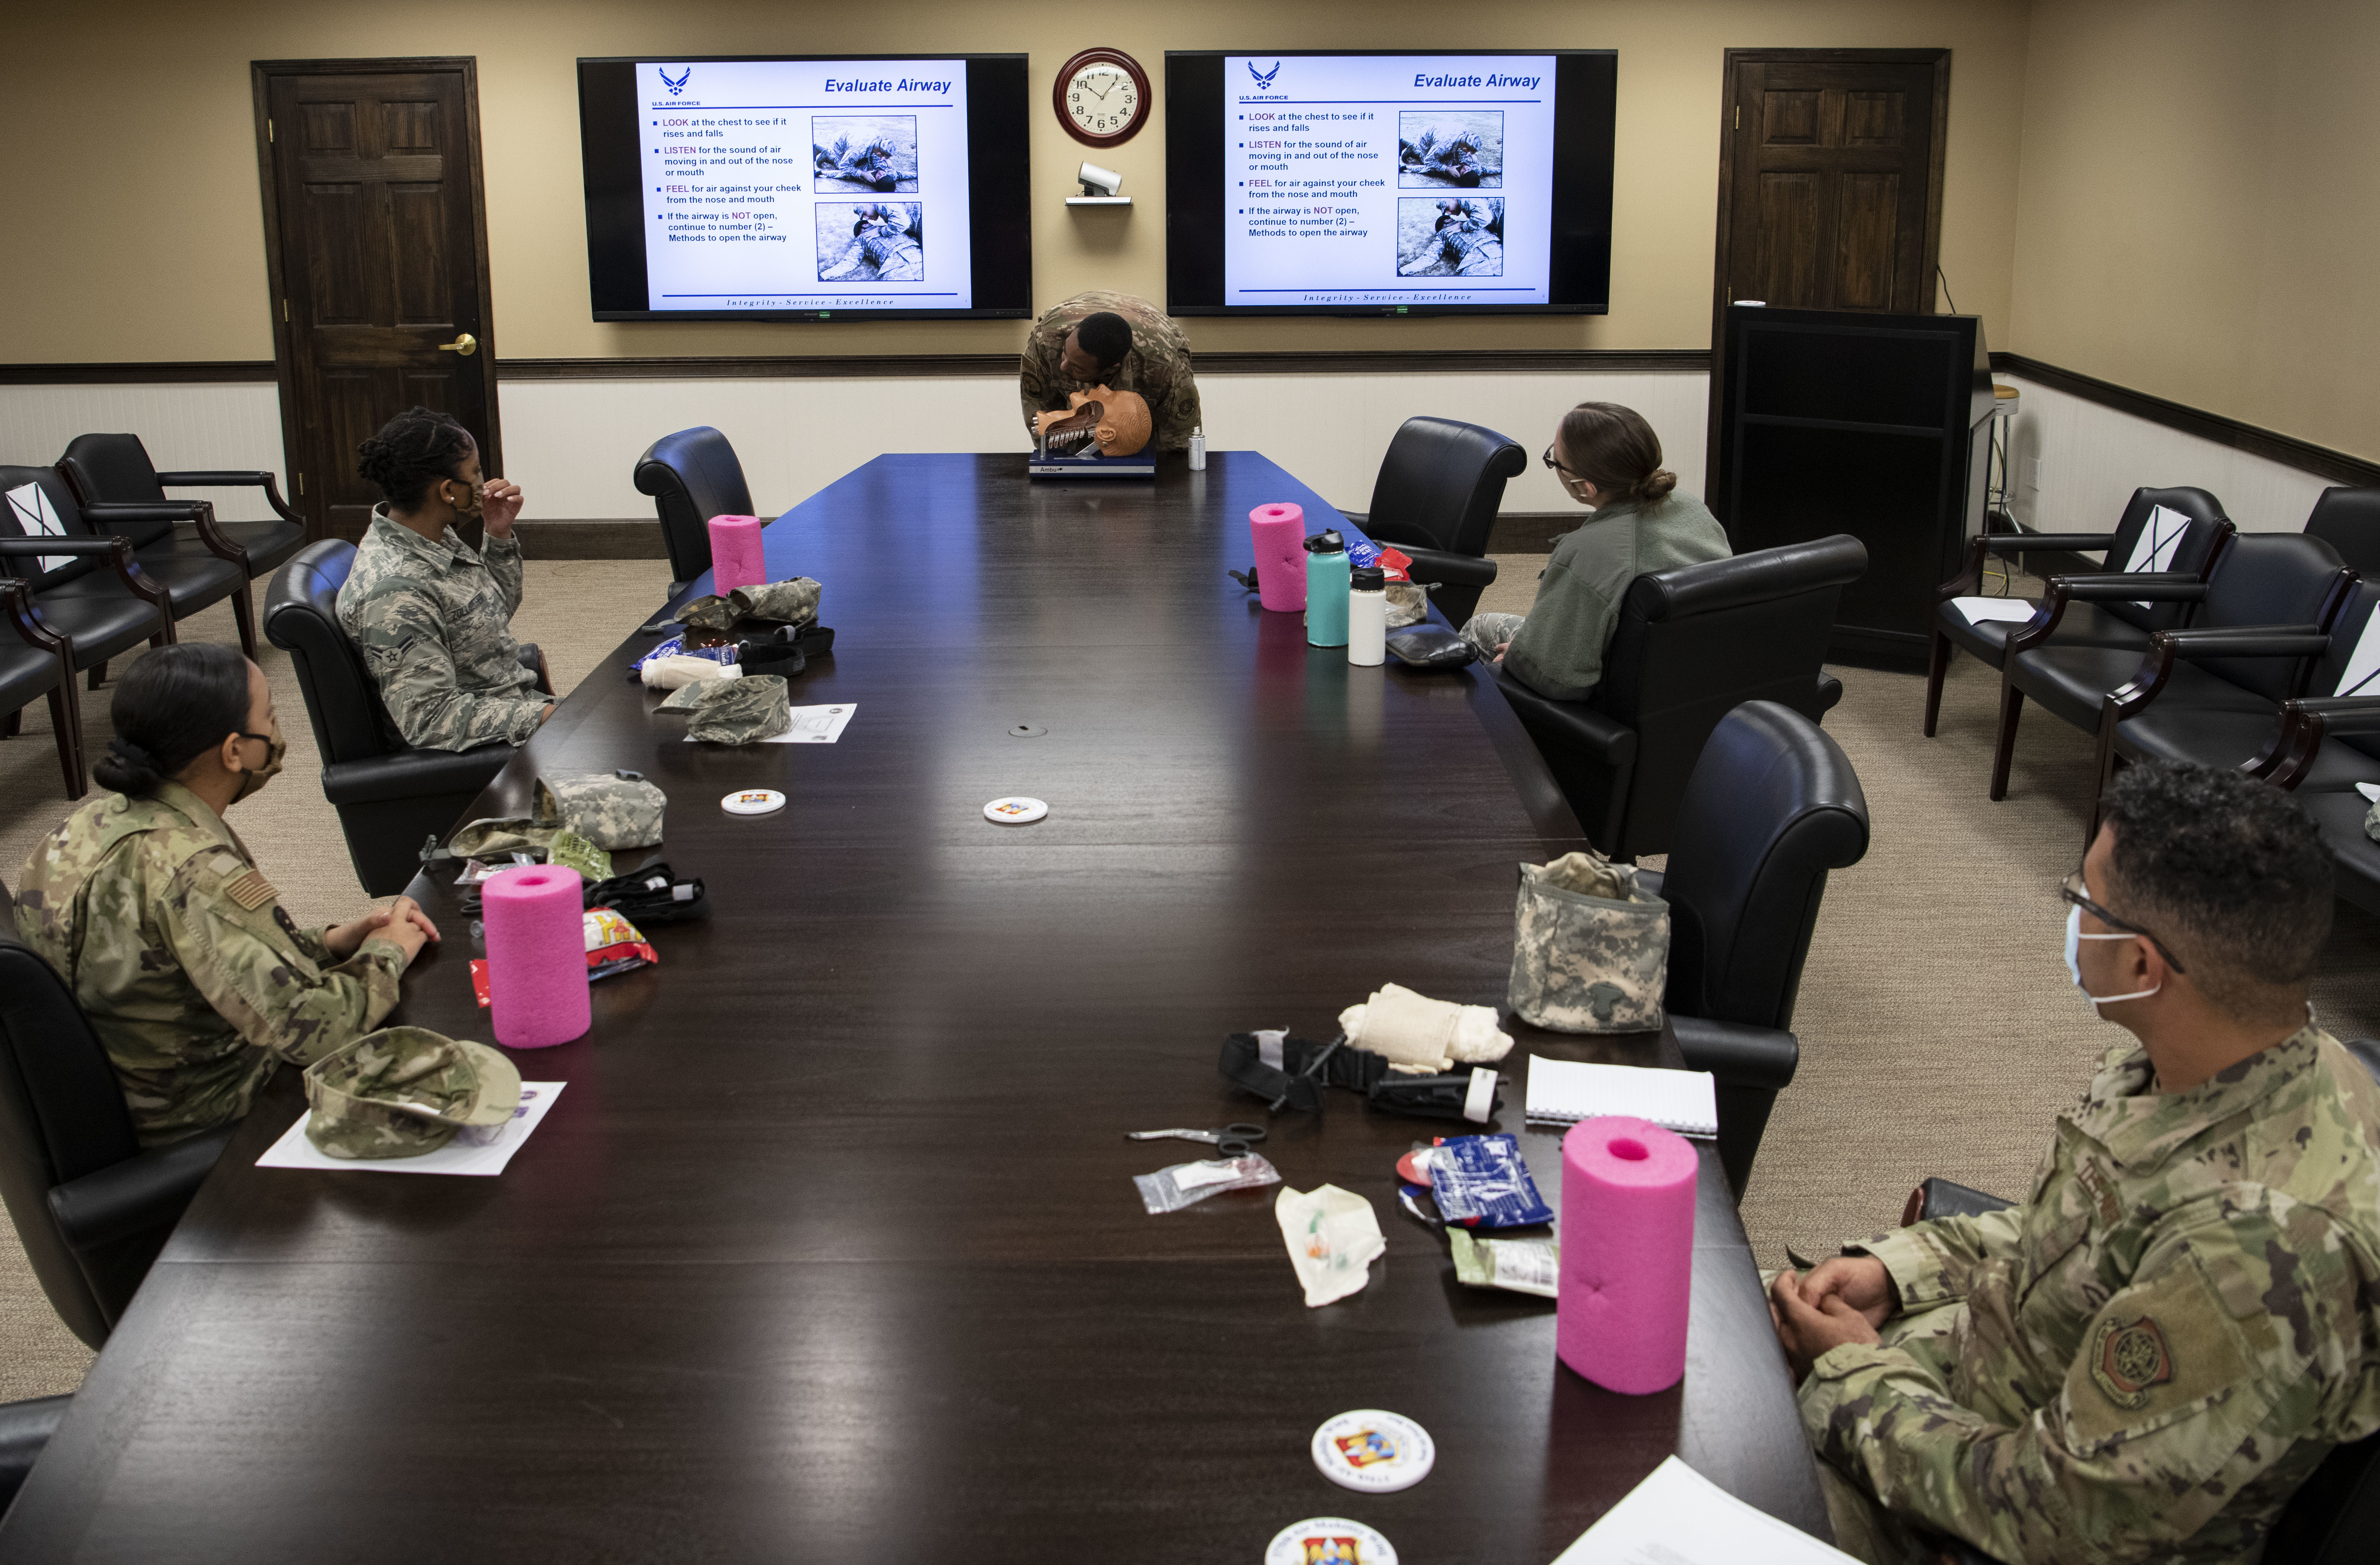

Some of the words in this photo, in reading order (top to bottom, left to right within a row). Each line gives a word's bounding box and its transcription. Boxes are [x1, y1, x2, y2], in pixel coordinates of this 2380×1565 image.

[1087, 71, 1094, 79] 11
[824, 78, 893, 92] Evaluate
[896, 78, 952, 95] Airway
[1077, 81, 1087, 89] 10
[1121, 82, 1128, 90] 2
[1413, 74, 1482, 88] Evaluate
[1485, 74, 1541, 90] Airway
[1072, 93, 1080, 102] 9
[1125, 95, 1132, 104] 3
[1076, 106, 1084, 115] 8
[1119, 107, 1128, 116] 4
[1086, 115, 1093, 124] 7
[1110, 116, 1118, 125] 5
[1249, 112, 1276, 121] LOOK
[1288, 112, 1302, 121] the
[1304, 112, 1329, 121] chest
[1330, 112, 1340, 121] to
[1360, 112, 1366, 120] if
[1368, 112, 1374, 120] it
[662, 118, 689, 127] LOOK
[701, 118, 716, 126] the
[718, 118, 742, 126] chest
[773, 117, 779, 126] if
[781, 117, 787, 126] it
[1097, 119, 1105, 128] 6
[1249, 124, 1270, 132] rises
[1272, 123, 1289, 132] and
[1291, 123, 1310, 132] falls
[663, 130, 685, 138] rises
[686, 129, 703, 137] and
[705, 129, 724, 137] falls
[1249, 140, 1281, 149] LISTEN
[1283, 140, 1297, 148] for
[1298, 140, 1313, 148] the
[1314, 140, 1342, 148] sound
[1344, 140, 1354, 148] of
[1355, 140, 1367, 148] air
[664, 146, 696, 154] LISTEN
[698, 146, 711, 154] for
[713, 146, 727, 154] the
[729, 145, 757, 154] sound
[759, 145, 768, 153] of
[770, 145, 782, 153] air
[1249, 152, 1281, 161] moving
[1284, 151, 1292, 160] in
[1294, 151, 1311, 159] and
[1329, 151, 1339, 159] of
[1340, 151, 1355, 159] the
[665, 157, 697, 167] moving
[699, 157, 707, 165] in
[710, 157, 726, 165] and
[745, 156, 754, 164] of
[755, 156, 770, 164] the
[1260, 162, 1288, 171] mouth
[677, 168, 704, 176] mouth
[1249, 179, 1273, 188] FEEL
[1274, 179, 1287, 187] for
[1289, 179, 1301, 187] air
[1302, 179, 1335, 189] against
[1337, 181, 1358, 189] your
[1359, 178, 1385, 187] cheek
[666, 185, 690, 193] FEEL
[691, 185, 704, 193] for
[706, 184, 718, 192] air
[719, 184, 752, 194] against
[753, 186, 774, 194] your
[776, 184, 802, 192] cheek
[1248, 190, 1269, 198] from
[1271, 190, 1285, 198] the
[1311, 190, 1328, 198] and
[1330, 190, 1358, 198] mouth
[666, 196, 687, 204] from
[689, 196, 703, 204] the
[728, 195, 745, 203] and
[747, 195, 775, 203] mouth
[1249, 207, 1255, 215] If
[1256, 207, 1271, 215] the
[1273, 207, 1302, 217] airway
[1303, 206, 1311, 215] is
[1314, 206, 1333, 214] NOT
[1335, 208, 1359, 216] open,
[667, 212, 674, 220] If
[675, 212, 689, 220] the
[691, 212, 719, 222] airway
[722, 212, 730, 220] is
[732, 212, 751, 220] NOT
[753, 213, 777, 221] open,
[1248, 218, 1287, 226] continue
[1300, 217, 1334, 225] number
[1336, 217, 1347, 227] (2)
[668, 223, 706, 231] continue
[719, 222, 752, 231] number
[754, 222, 766, 232] (2)
[1248, 229, 1286, 237] Methods
[1299, 230, 1321, 238] open
[1323, 228, 1337, 236] the
[1339, 228, 1368, 238] airway
[669, 234, 706, 242] Methods
[719, 235, 741, 243] open
[742, 233, 756, 241] the
[759, 233, 787, 243] airway
[1303, 294, 1353, 302] Integrity
[726, 299, 777, 307] Integrity
